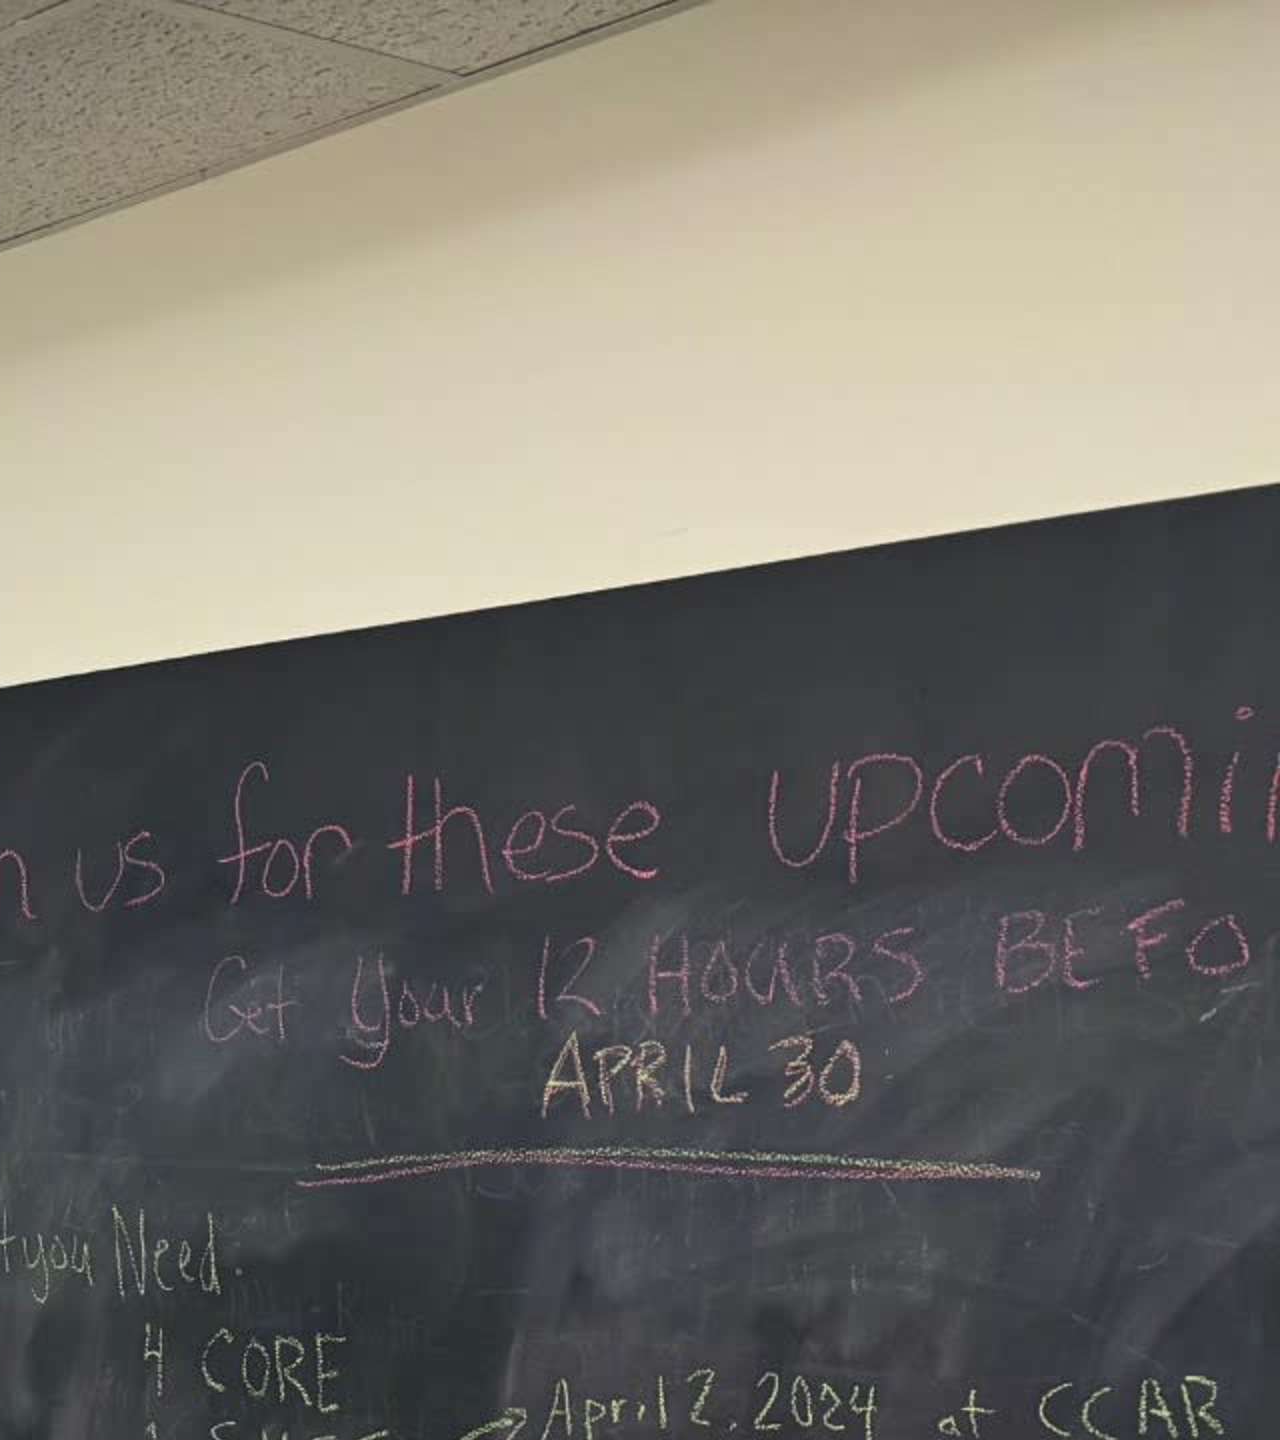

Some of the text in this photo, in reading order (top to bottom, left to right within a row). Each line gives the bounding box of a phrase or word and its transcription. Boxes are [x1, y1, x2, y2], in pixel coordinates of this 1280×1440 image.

[75, 831, 165, 912] us
[219, 760, 353, 904] for
[386, 773, 661, 896] these
[204, 955, 298, 1043] Get
[538, 935, 603, 1019] 12
[647, 927, 926, 1016] HOURS
[541, 1030, 862, 1120] APRIL 30
[22, 1233, 94, 1304] you
[143, 1322, 348, 1413] 4 CORE
[938, 1388, 999, 1439] at
